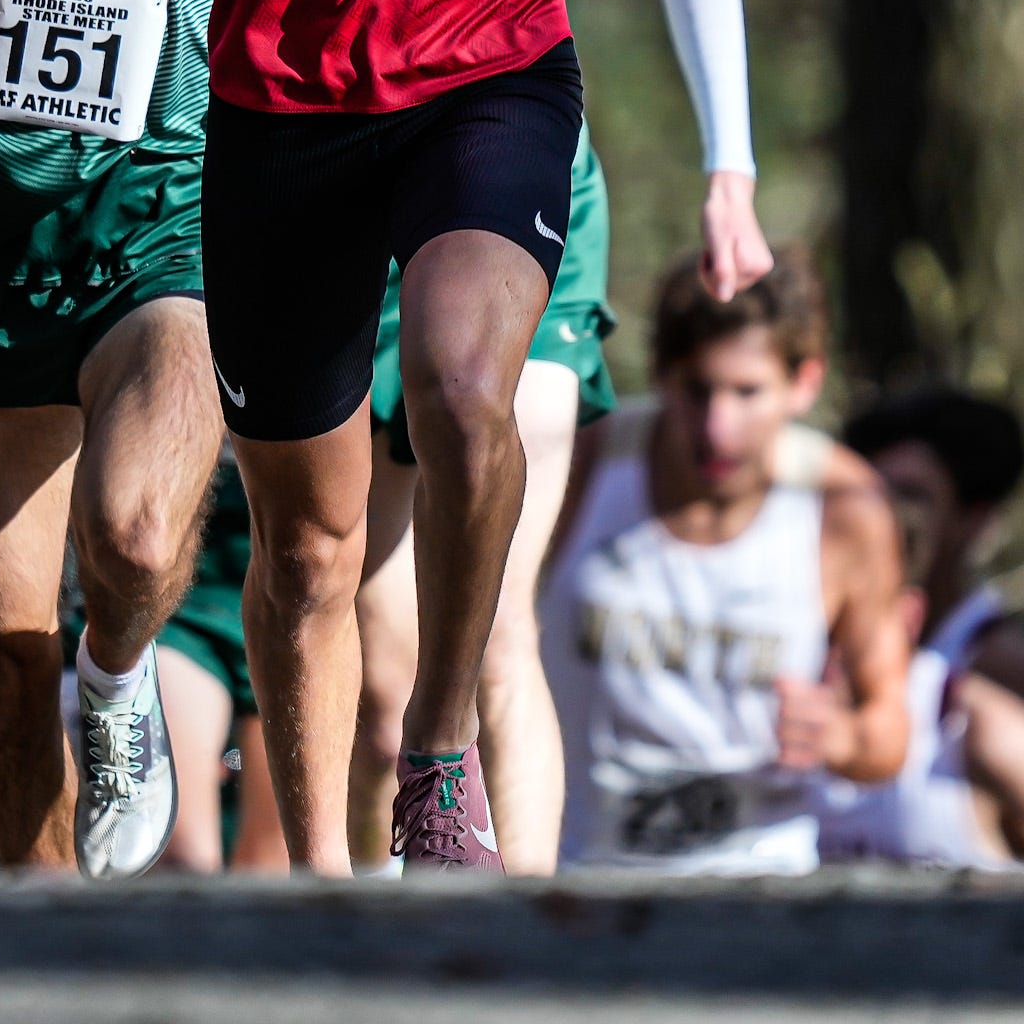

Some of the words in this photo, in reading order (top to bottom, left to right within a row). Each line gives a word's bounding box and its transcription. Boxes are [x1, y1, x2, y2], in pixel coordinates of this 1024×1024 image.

[22, 7, 69, 25] STATE
[73, 16, 116, 31] MEET
[70, 2, 129, 20] ISLAND
[0, 20, 122, 100] 151
[20, 94, 122, 126] ATHLETIC
